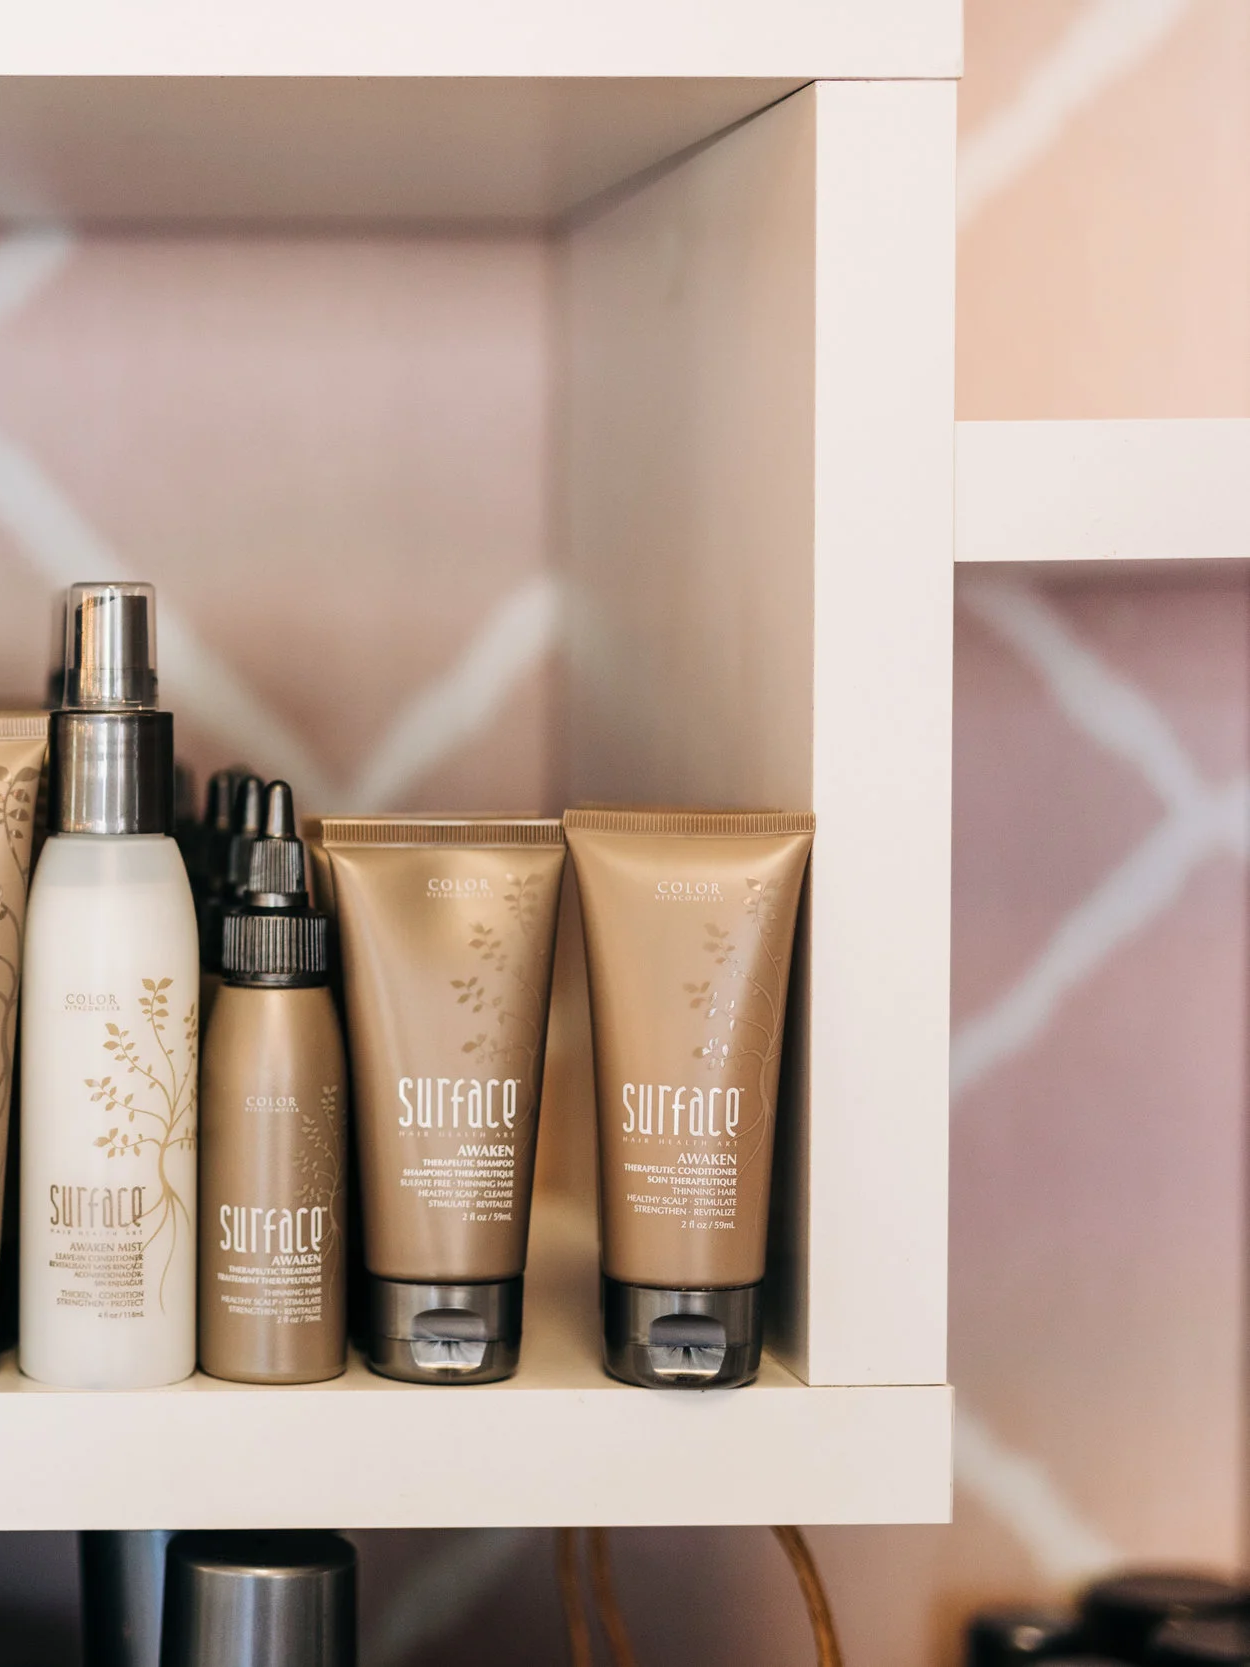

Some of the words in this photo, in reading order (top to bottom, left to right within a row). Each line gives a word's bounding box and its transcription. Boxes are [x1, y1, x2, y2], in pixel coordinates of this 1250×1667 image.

[428, 878, 490, 891] COLOR
[657, 881, 720, 894] COLOR
[66, 994, 117, 1004] COLOR
[246, 1096, 297, 1106] COLOR
[623, 1136, 649, 1144] HAIR
[659, 1138, 706, 1146] HEALTH
[457, 1145, 514, 1157] AWAKEN
[677, 1153, 737, 1165] AWAKEN
[455, 1170, 514, 1179] THERAPEUTIQUE
[624, 1164, 676, 1174] THERAPEUTIC
[678, 1167, 737, 1175] CONDITIONER
[457, 1180, 495, 1188] THINNING
[647, 1176, 668, 1184] SOIN
[670, 1177, 737, 1187] THERAPEUTIQUE
[419, 1189, 452, 1197] HEALTHY
[455, 1190, 478, 1198] SCALP
[484, 1190, 513, 1198] CLEANSE
[672, 1187, 715, 1196] THINNING
[718, 1188, 736, 1196] HAIR
[477, 1200, 512, 1208] REVITALIZE
[627, 1194, 660, 1204] HEALTHY
[634, 1205, 686, 1215] STRENGTHEN
[462, 1213, 467, 1221] 2
[470, 1213, 475, 1221] fl
[690, 1220, 694, 1228] fl
[70, 1242, 114, 1251] AWAKEN
[118, 1242, 142, 1251] MIST
[271, 1254, 321, 1266] AWAKEN
[99, 1291, 144, 1299] CONDITION
